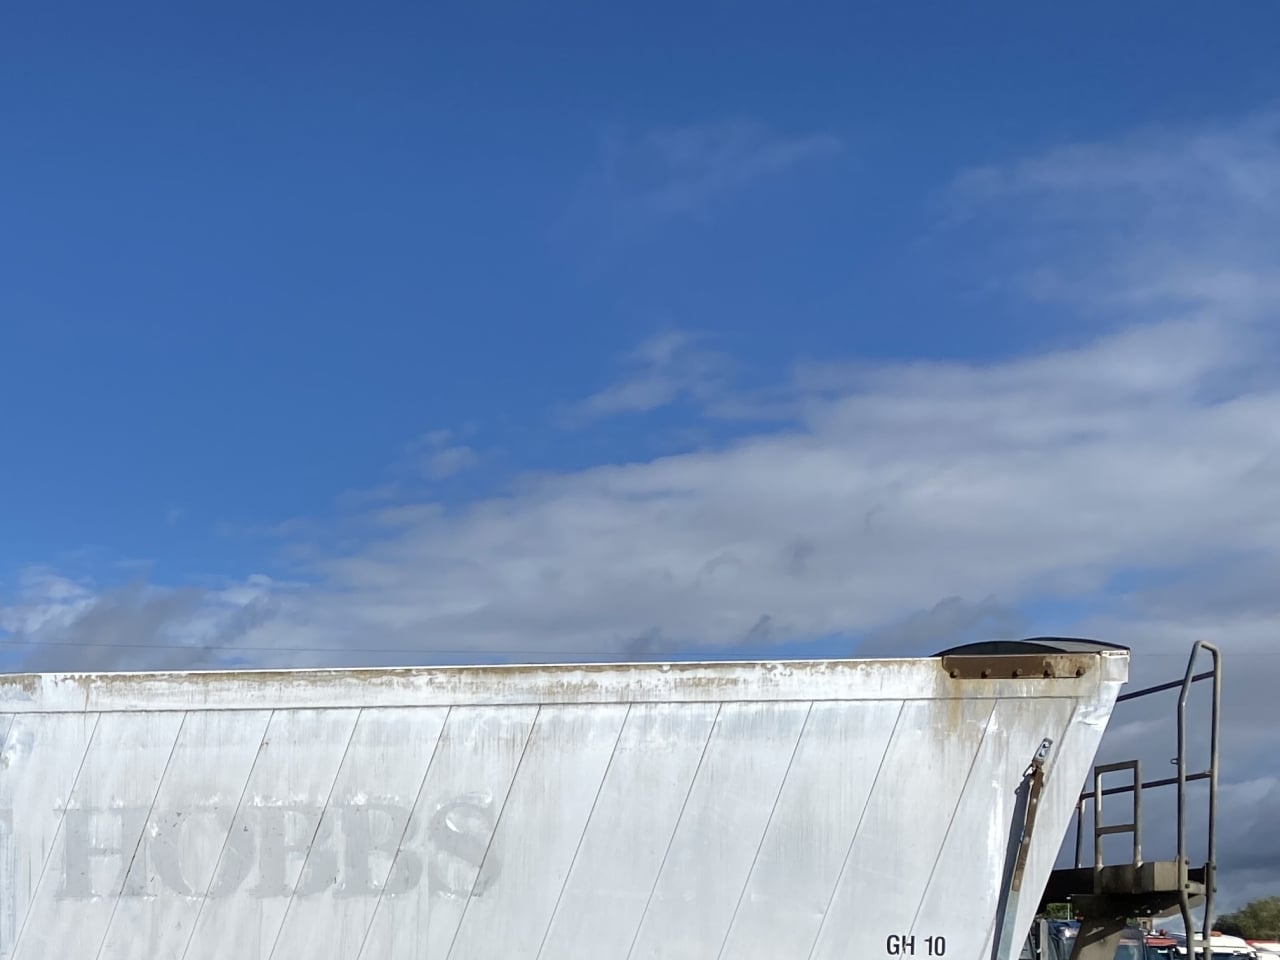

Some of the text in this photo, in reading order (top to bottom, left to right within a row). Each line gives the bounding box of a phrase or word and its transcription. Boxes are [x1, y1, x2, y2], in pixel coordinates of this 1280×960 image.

[52, 800, 503, 900] HOBBS
[886, 934, 946, 957] GH 10
